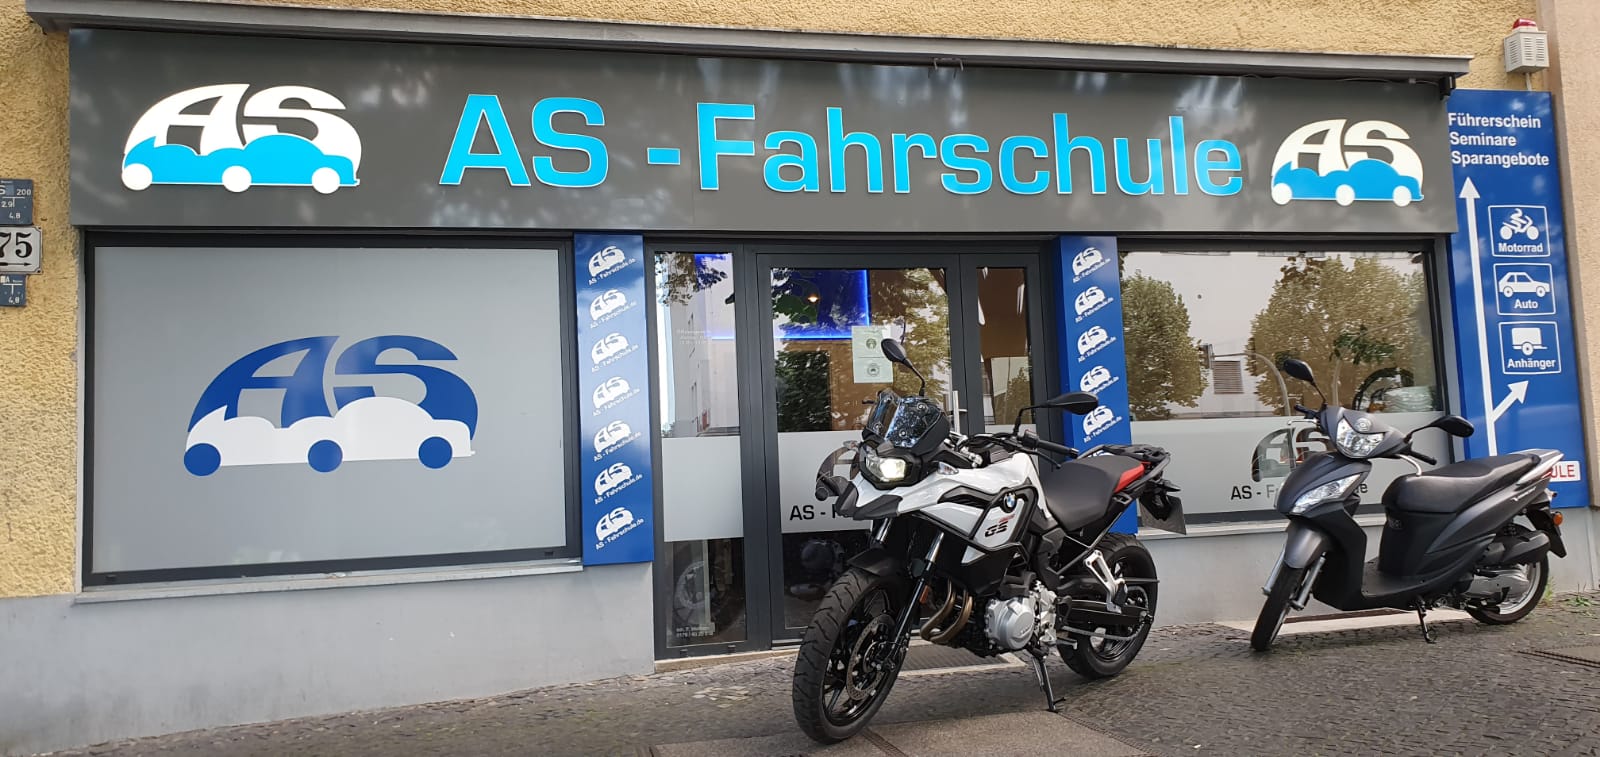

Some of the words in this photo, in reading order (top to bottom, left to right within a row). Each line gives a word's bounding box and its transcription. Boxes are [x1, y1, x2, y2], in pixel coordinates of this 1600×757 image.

[1448, 112, 1542, 129] Führerschein
[122, 83, 362, 186] AS
[1450, 131, 1517, 147] Seminare
[438, 93, 609, 188] AS
[696, 102, 1243, 196] Fahrschule
[1271, 119, 1424, 200] AS
[1451, 150, 1550, 169] Sparangebote
[16, 188, 32, 196] 200
[1498, 242, 1544, 254] Motorrad
[1514, 298, 1539, 310] Auto
[1507, 356, 1557, 370] Anhänger
[186, 334, 479, 456] AS
[1230, 484, 1253, 501] AS
[789, 504, 815, 521] AS
[984, 520, 1008, 537] GS
